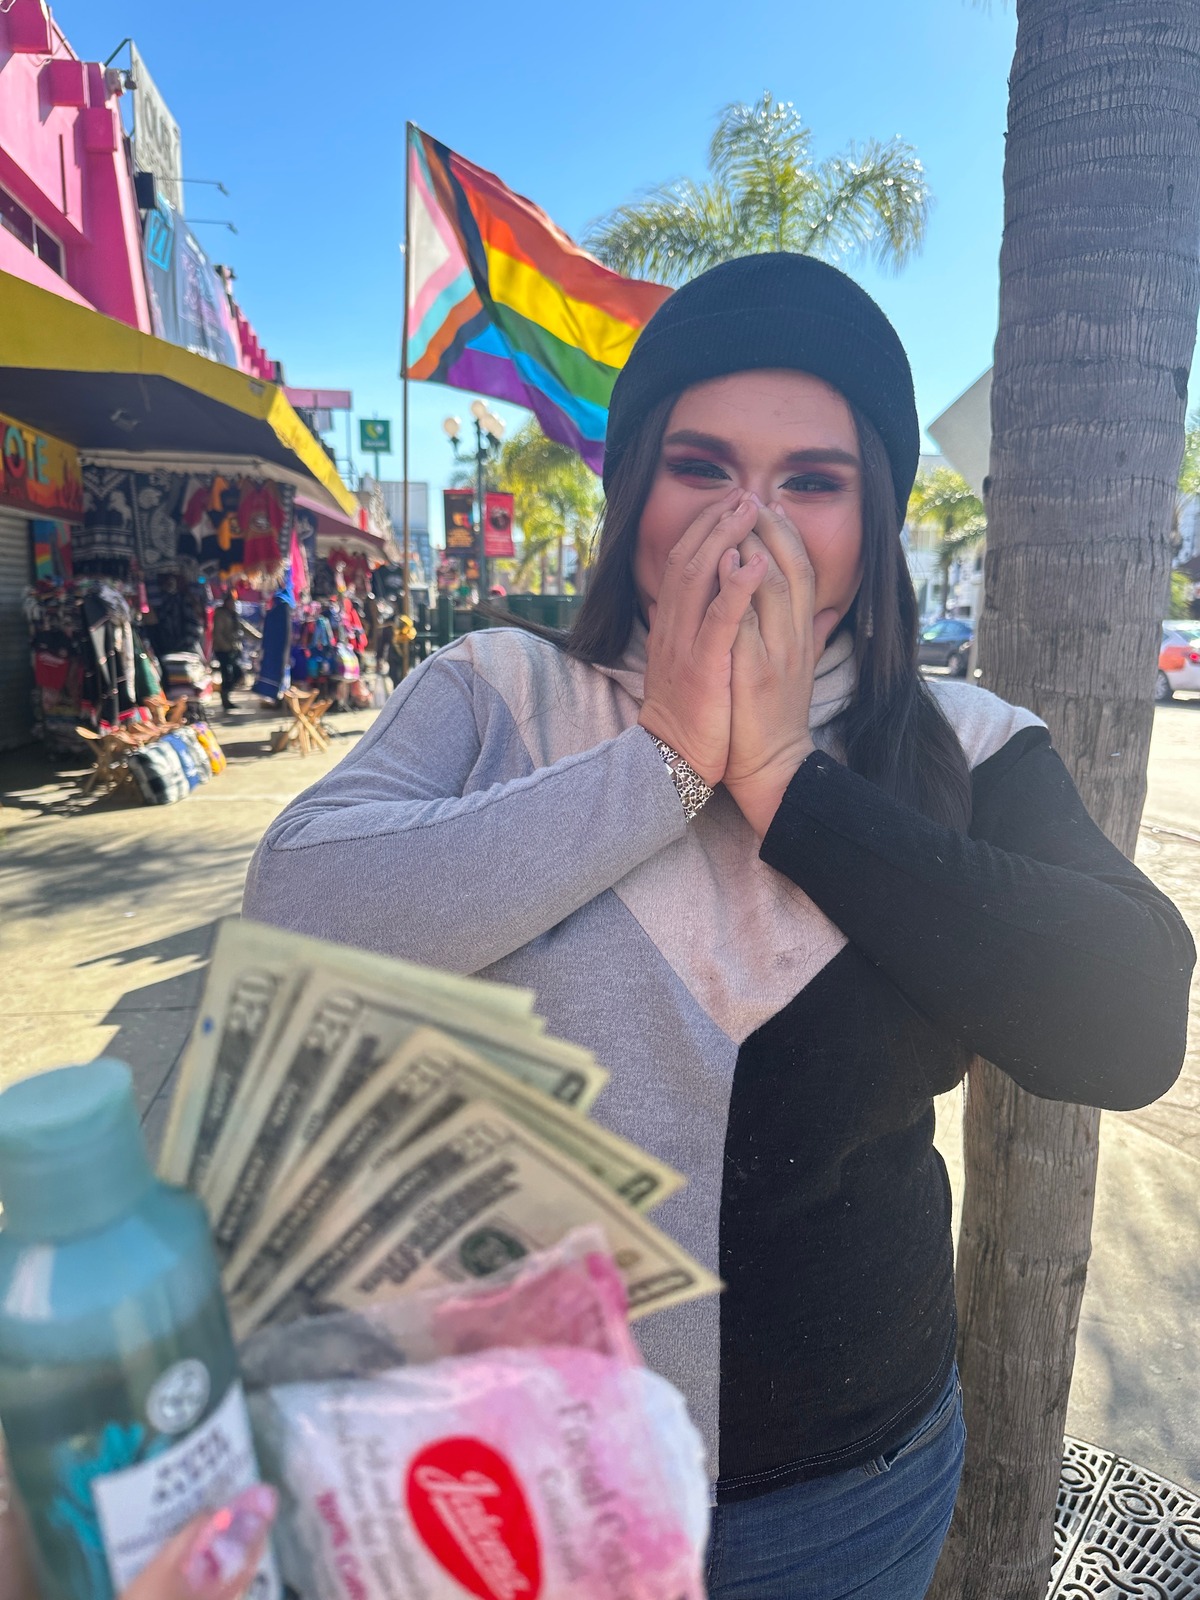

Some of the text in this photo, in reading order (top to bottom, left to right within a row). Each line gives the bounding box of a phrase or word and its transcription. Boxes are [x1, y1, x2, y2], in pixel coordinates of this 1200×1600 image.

[0, 426, 49, 488] OTE
[228, 972, 277, 1034] 20
[304, 992, 360, 1054] 20
